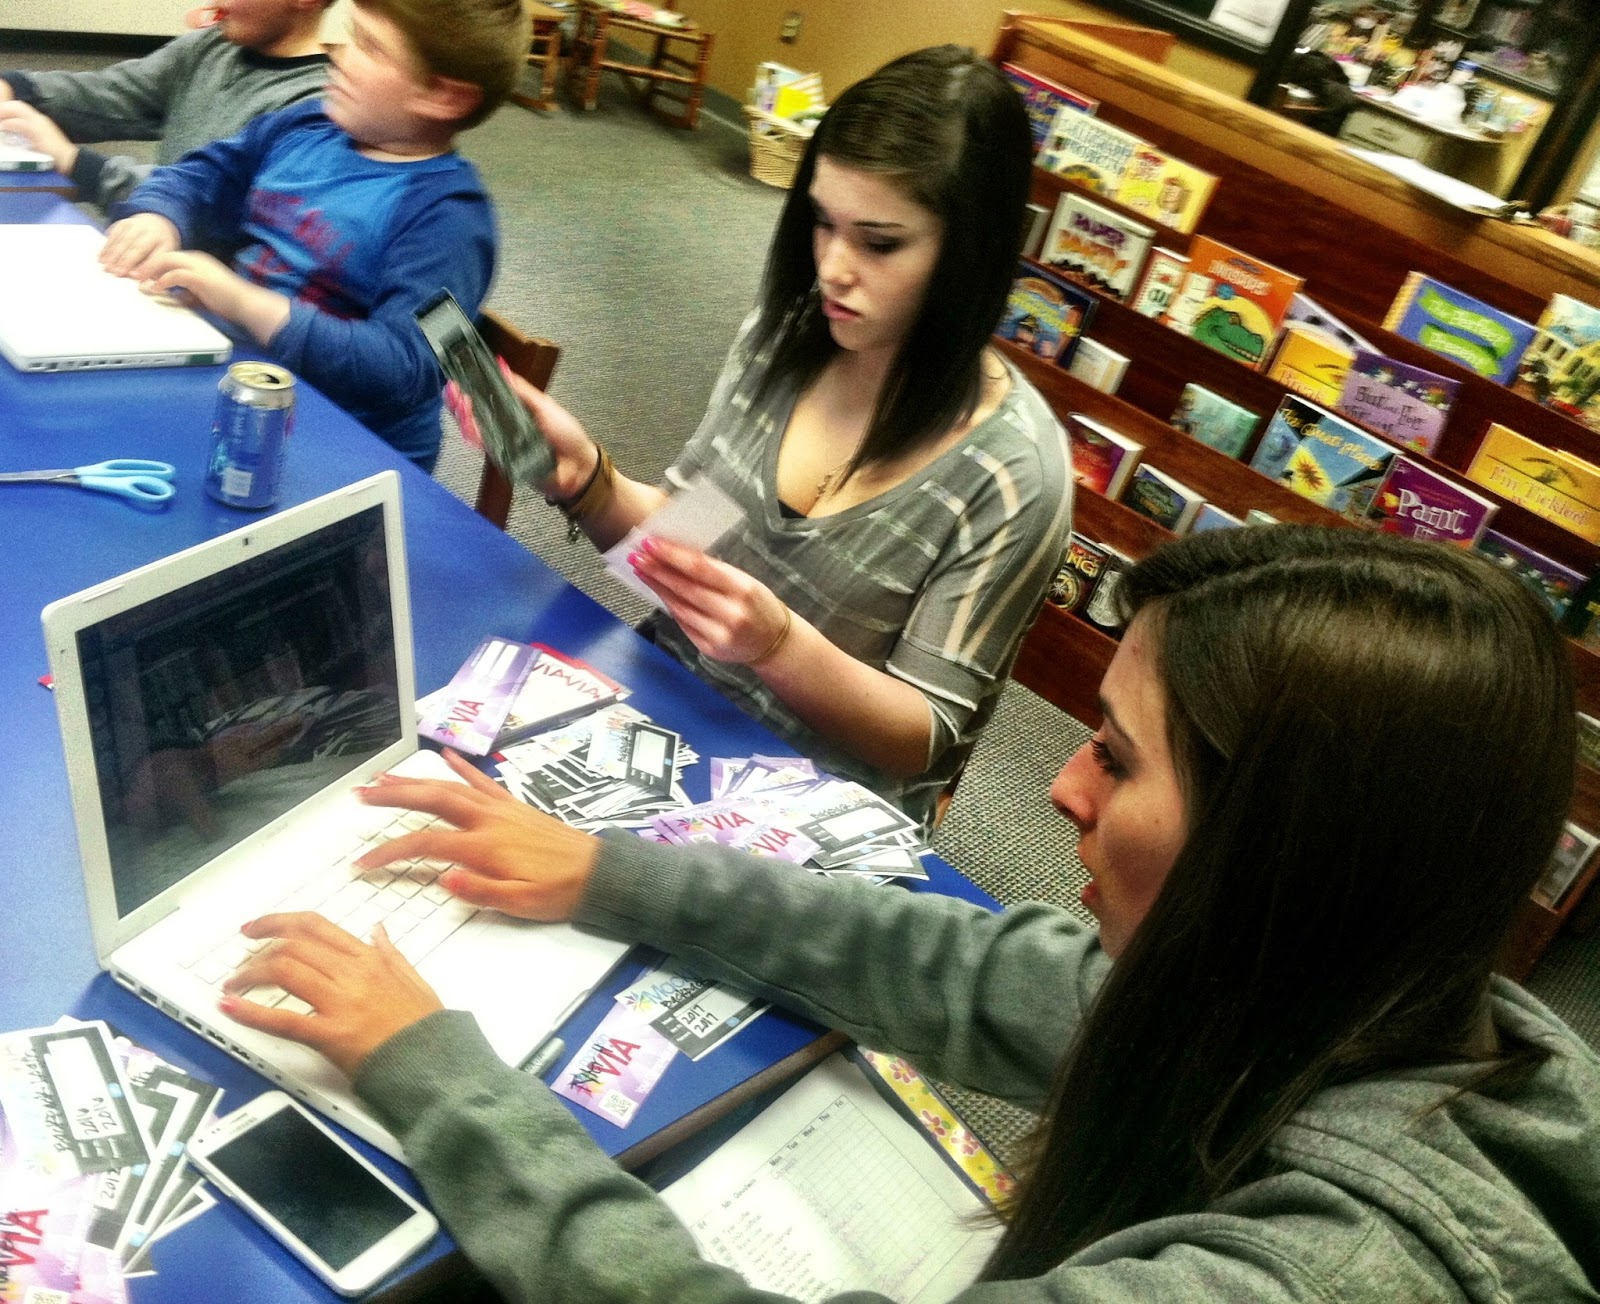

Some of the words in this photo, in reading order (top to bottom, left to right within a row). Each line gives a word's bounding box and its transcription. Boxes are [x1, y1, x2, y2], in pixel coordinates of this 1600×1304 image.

[1395, 487, 1472, 535] Paint
[447, 699, 485, 724] VIA
[700, 811, 755, 831] VIA
[751, 827, 797, 853] VIA
[681, 1003, 705, 1025] 2017
[694, 1012, 719, 1034] 2017
[596, 1037, 642, 1077] VIA
[769, 1155, 783, 1167] Mon
[786, 1141, 799, 1151] Tue
[802, 1125, 816, 1137] Wed
[818, 1112, 830, 1122] Thu
[834, 1100, 844, 1108] Fri
[0, 1209, 49, 1267] VIA
